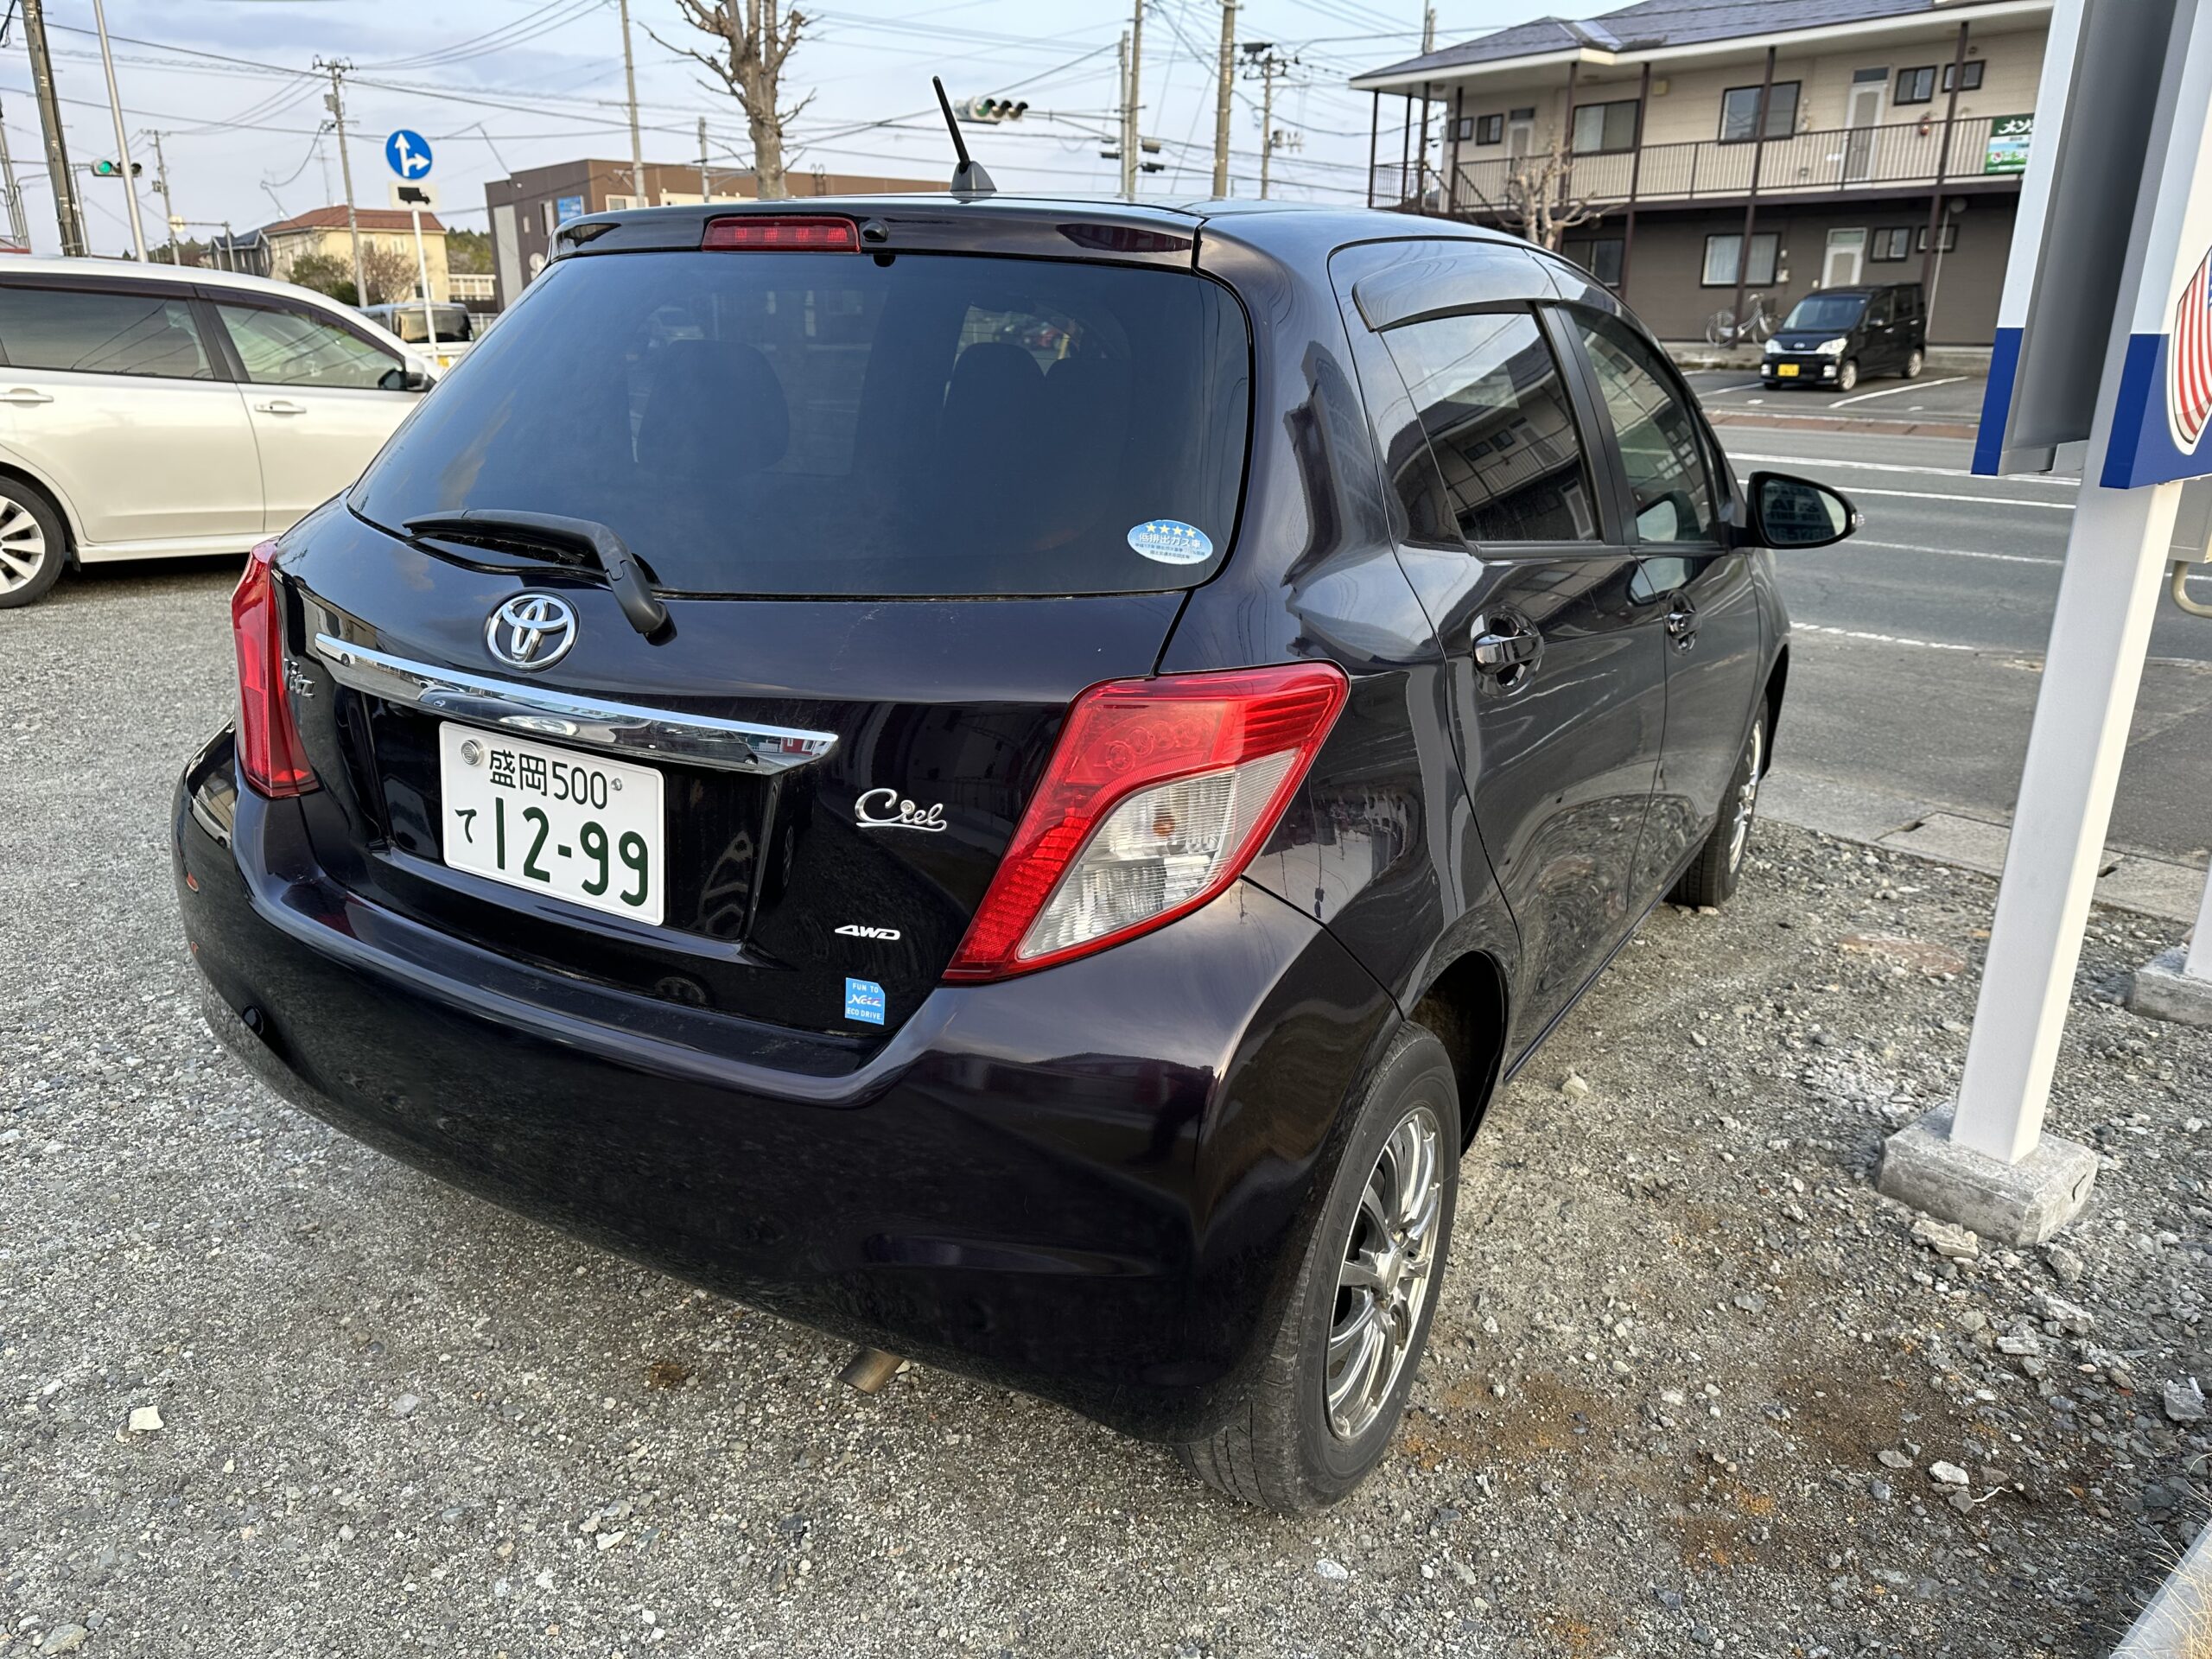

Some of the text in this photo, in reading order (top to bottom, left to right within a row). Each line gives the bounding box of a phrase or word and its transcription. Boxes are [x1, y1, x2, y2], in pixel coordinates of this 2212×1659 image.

[1139, 532, 1202, 550] 低排出ガス車
[489, 749, 607, 810] 盛岡500
[855, 787, 947, 832] Ciel
[454, 797, 649, 906] て 12-99
[835, 925, 900, 941] 4WD
[853, 982, 867, 992] FUN
[847, 1007, 859, 1016] ECO
